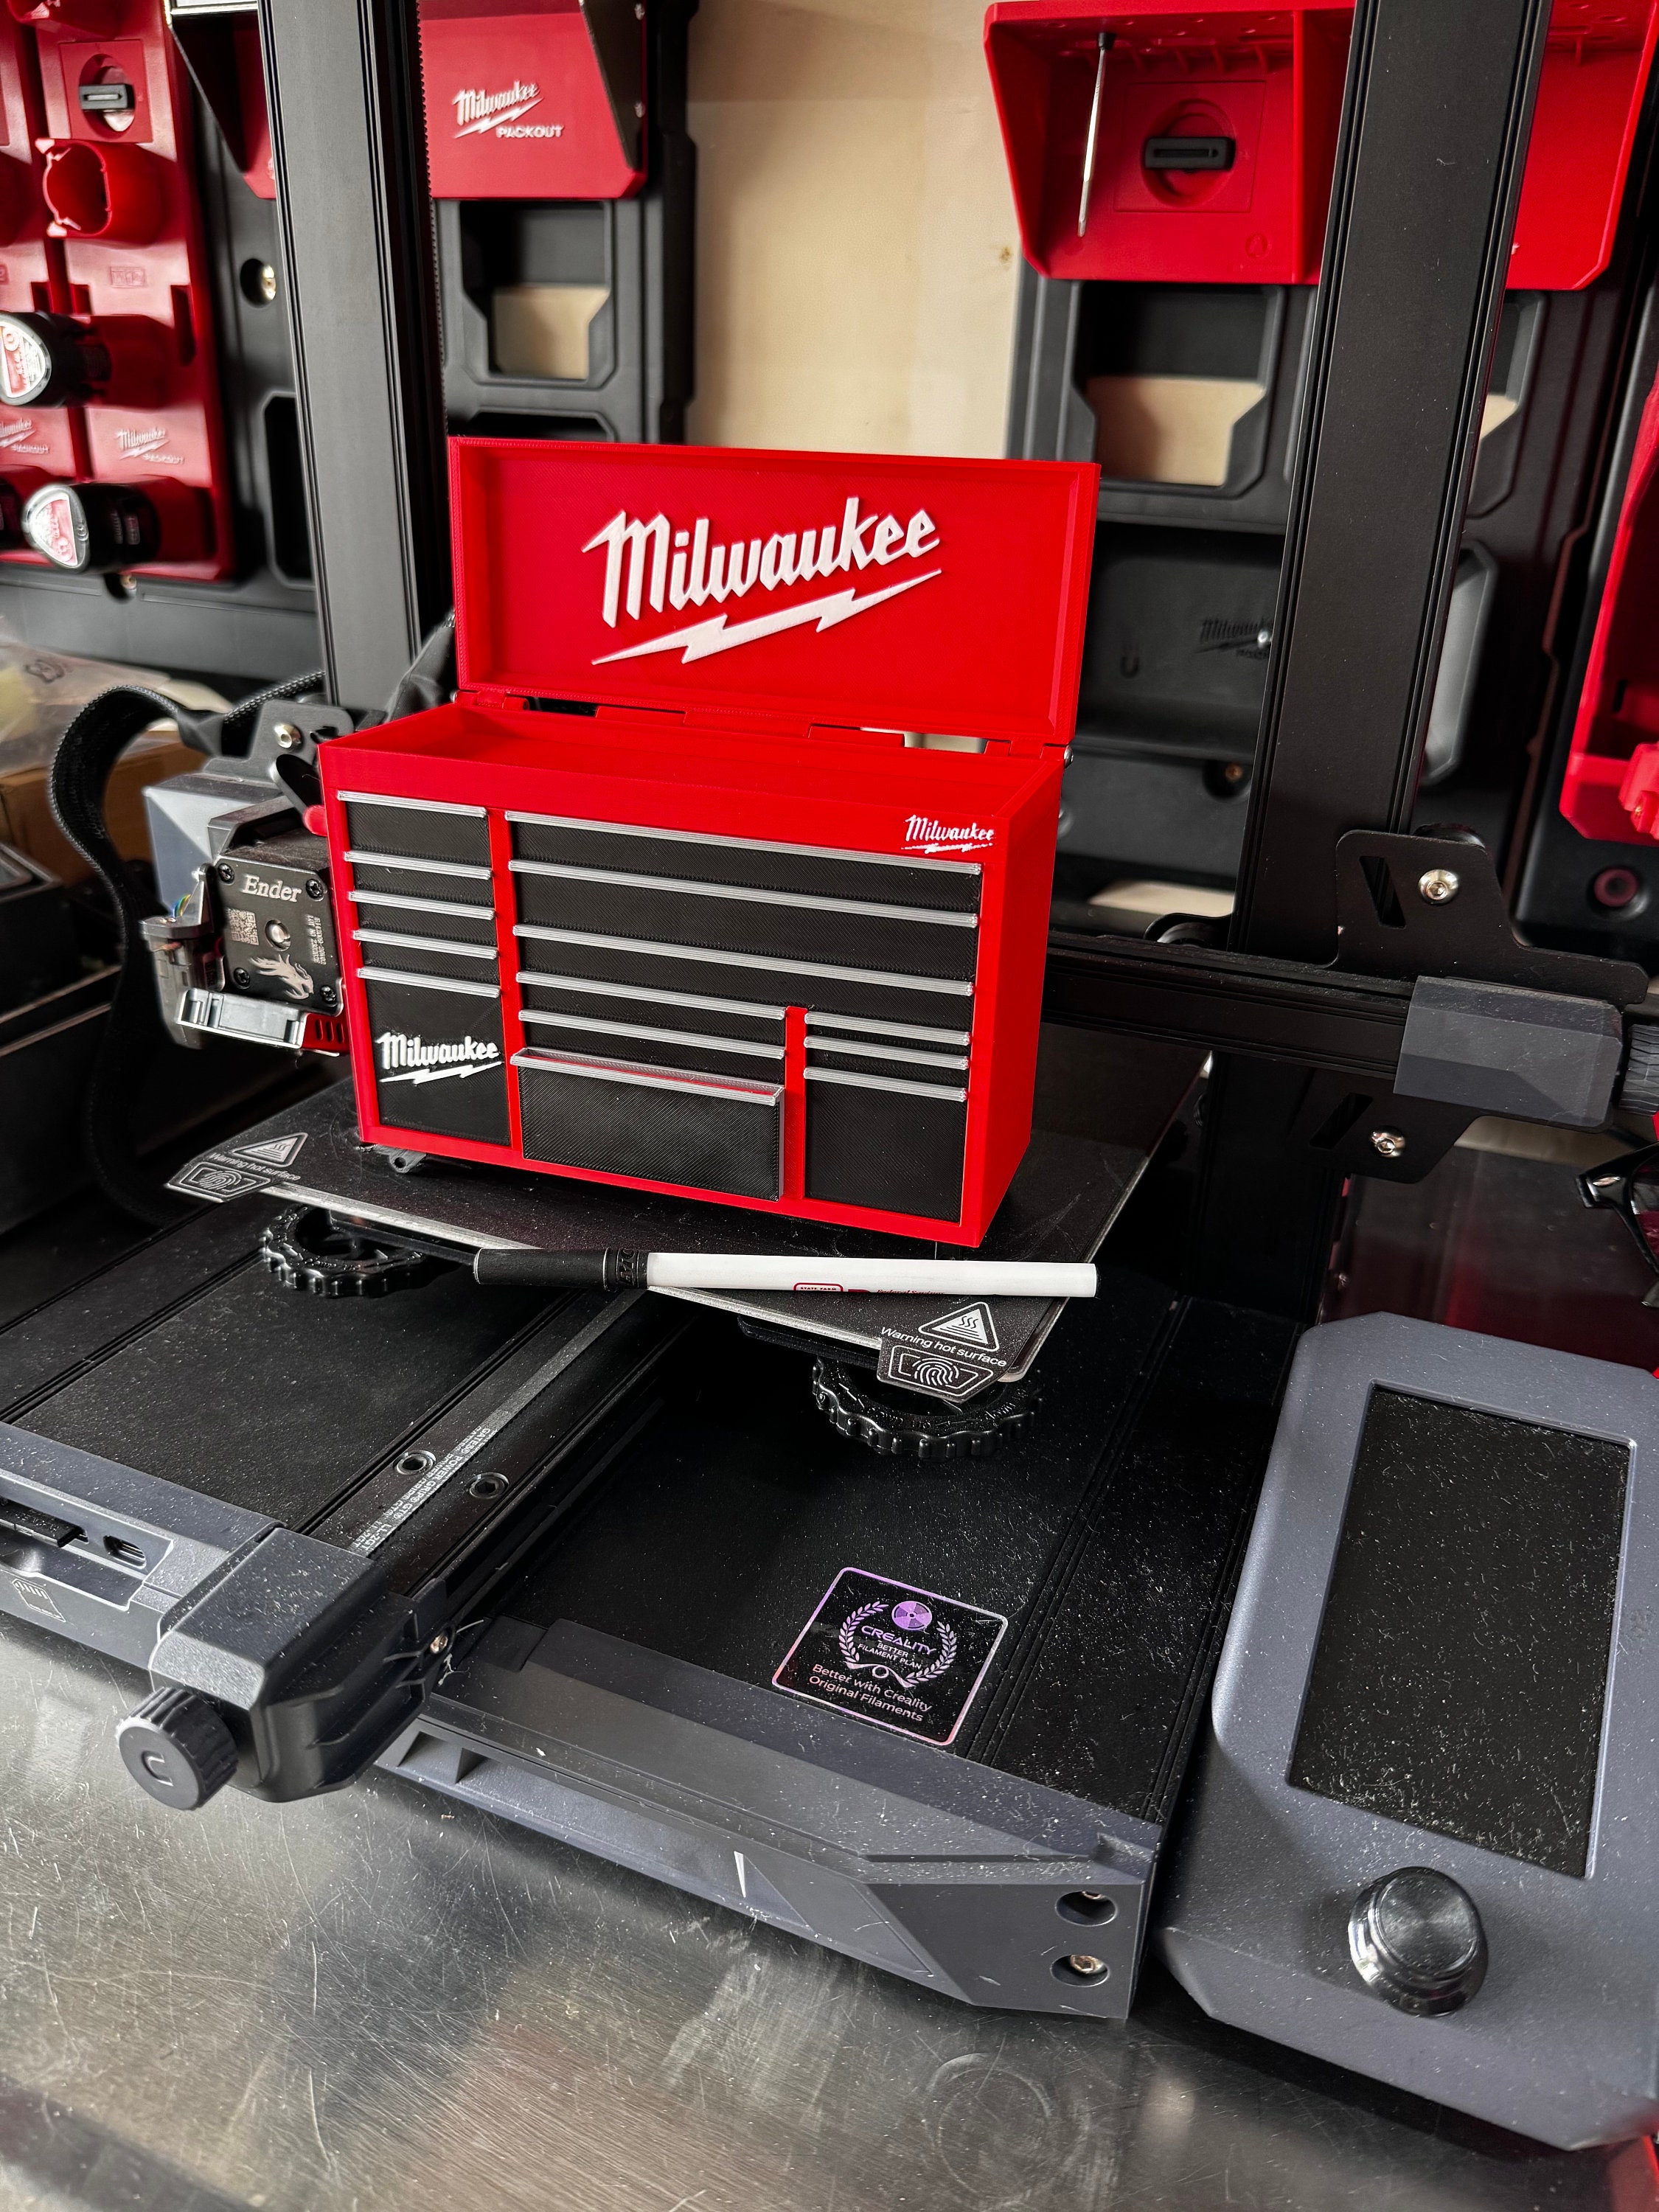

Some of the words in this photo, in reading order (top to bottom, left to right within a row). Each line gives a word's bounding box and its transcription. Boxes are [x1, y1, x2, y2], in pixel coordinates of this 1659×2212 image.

[452, 80, 540, 126] Milwaukee
[495, 125, 565, 139] PACKOUT
[582, 496, 940, 628] Milwaukee
[905, 814, 995, 841] Milwaukee
[241, 874, 302, 902] Ender
[375, 1032, 501, 1070] Milwaukee
[209, 1152, 248, 1169] Warning
[246, 1163, 265, 1173] hot
[262, 1167, 301, 1181] surface
[881, 1326, 933, 1349] Warning
[934, 1341, 956, 1354] hot
[956, 1349, 1007, 1367] surface
[431, 1456, 463, 1481] POWER
[361, 1524, 392, 1551] LL-2GT
[861, 1625, 936, 1655] CREALITY
[877, 1641, 909, 1658] BETTER
[858, 1643, 897, 1661] FILAMENT
[900, 1658, 922, 1669] PLAN
[809, 1675, 859, 1700] Original
[860, 1694, 924, 1722] Filaments
[812, 1663, 853, 1683] Better
[854, 1677, 881, 1695] with
[884, 1688, 933, 1713] Creality
